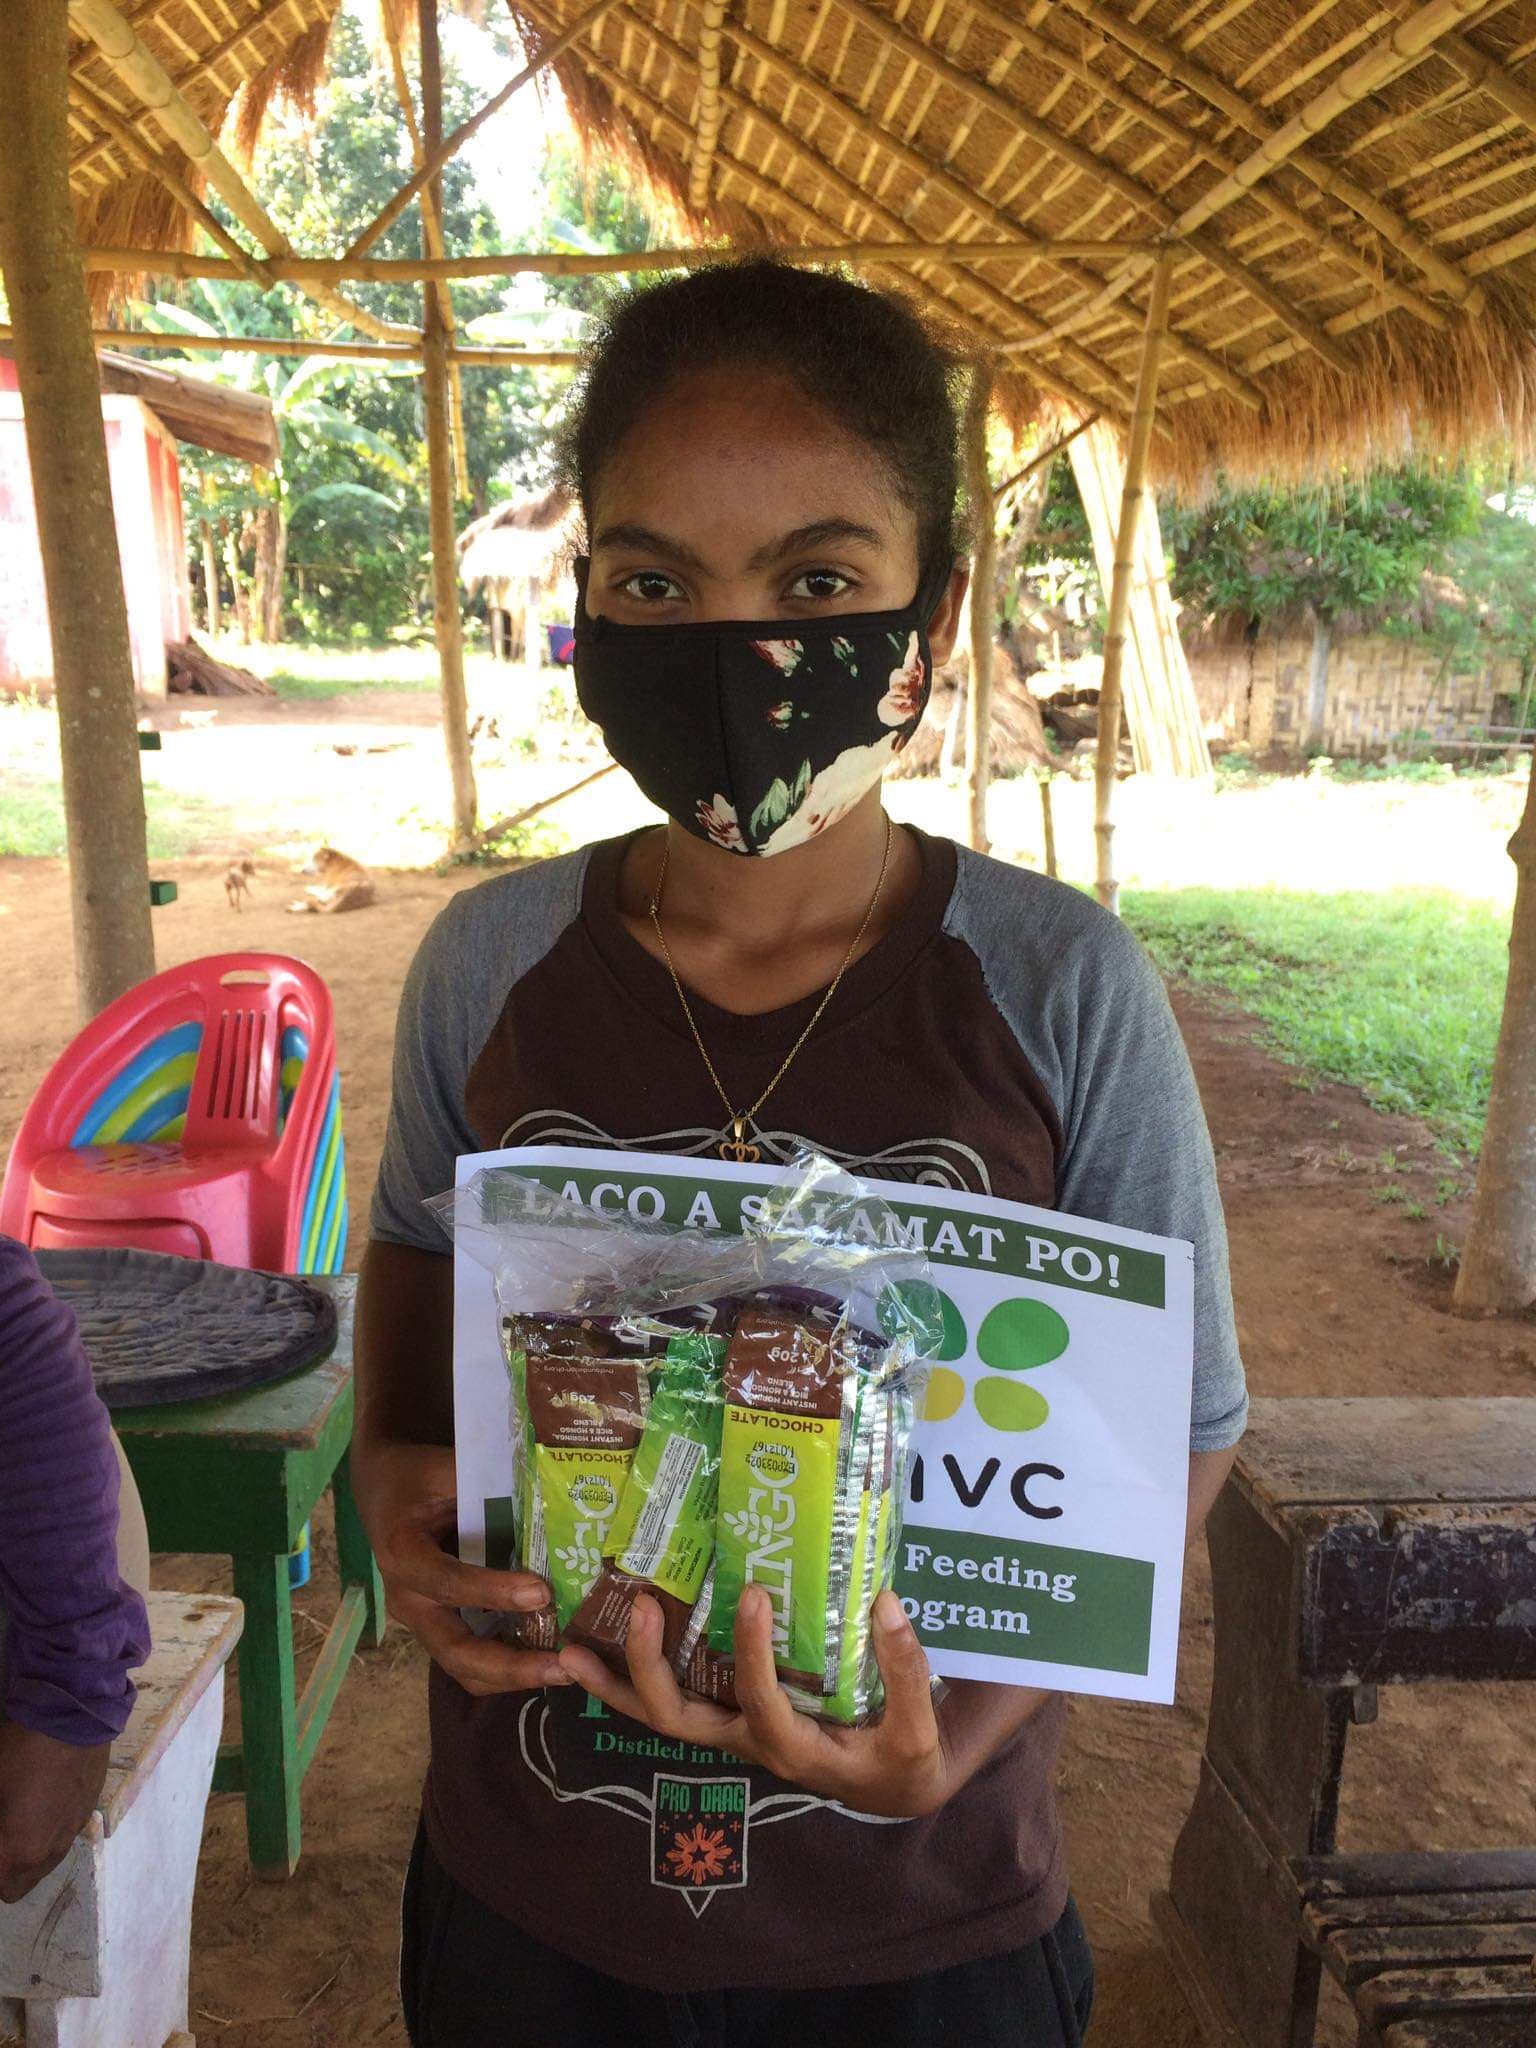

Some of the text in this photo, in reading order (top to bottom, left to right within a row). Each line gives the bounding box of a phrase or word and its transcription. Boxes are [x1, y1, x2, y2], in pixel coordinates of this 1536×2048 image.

[683, 1190, 721, 1229] A
[739, 1194, 1006, 1262] SALAMAT
[1025, 1236, 1120, 1288] PO!
[770, 1346, 799, 1363] 20g
[569, 1391, 596, 1405] 20g
[782, 1397, 817, 1409] INSTANT
[731, 1410, 824, 1434] CHOCOLATE
[591, 1434, 624, 1443] INSTANT
[903, 1543, 1077, 1603] Feeding
[593, 1731, 685, 1762] Distiled
[690, 1745, 714, 1764] in
[659, 1781, 690, 1813] PRO
